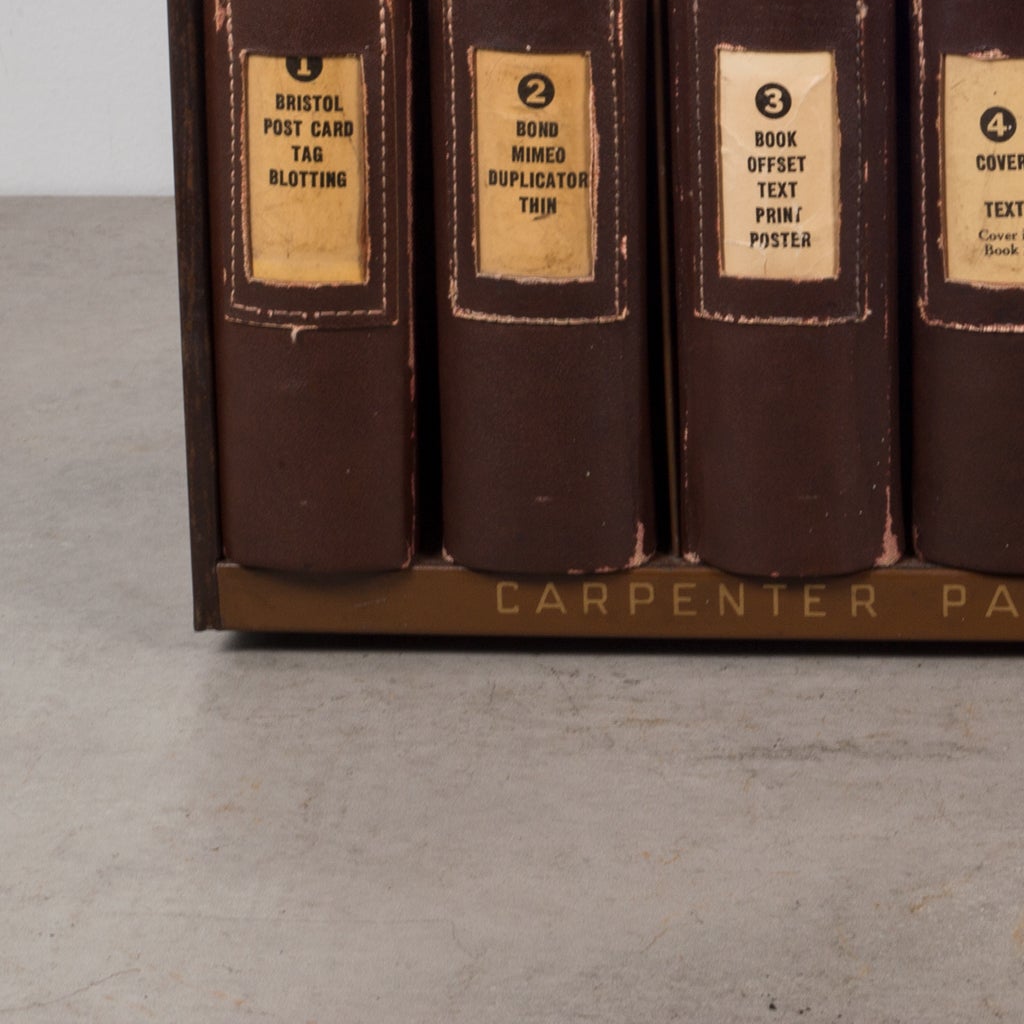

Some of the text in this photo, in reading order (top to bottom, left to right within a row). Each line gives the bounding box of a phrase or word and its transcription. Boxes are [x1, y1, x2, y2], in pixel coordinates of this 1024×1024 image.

[275, 93, 344, 113] BRISTOL
[263, 118, 354, 138] POST CARD
[516, 120, 559, 138] BOND
[754, 130, 797, 148] BOOK
[291, 145, 324, 163] TAG
[511, 145, 566, 164] MIMEO
[747, 155, 807, 173] OFFSET
[269, 168, 347, 189] BLOTTING
[488, 169, 590, 190] DUPLICATOR
[757, 181, 798, 199] TEXT
[519, 196, 557, 216] THIN
[984, 200, 1024, 218] TEXT
[749, 231, 812, 249] POSTER
[978, 229, 1018, 242] Cover
[984, 243, 1019, 256] Book
[495, 580, 880, 618] CARPENTER
